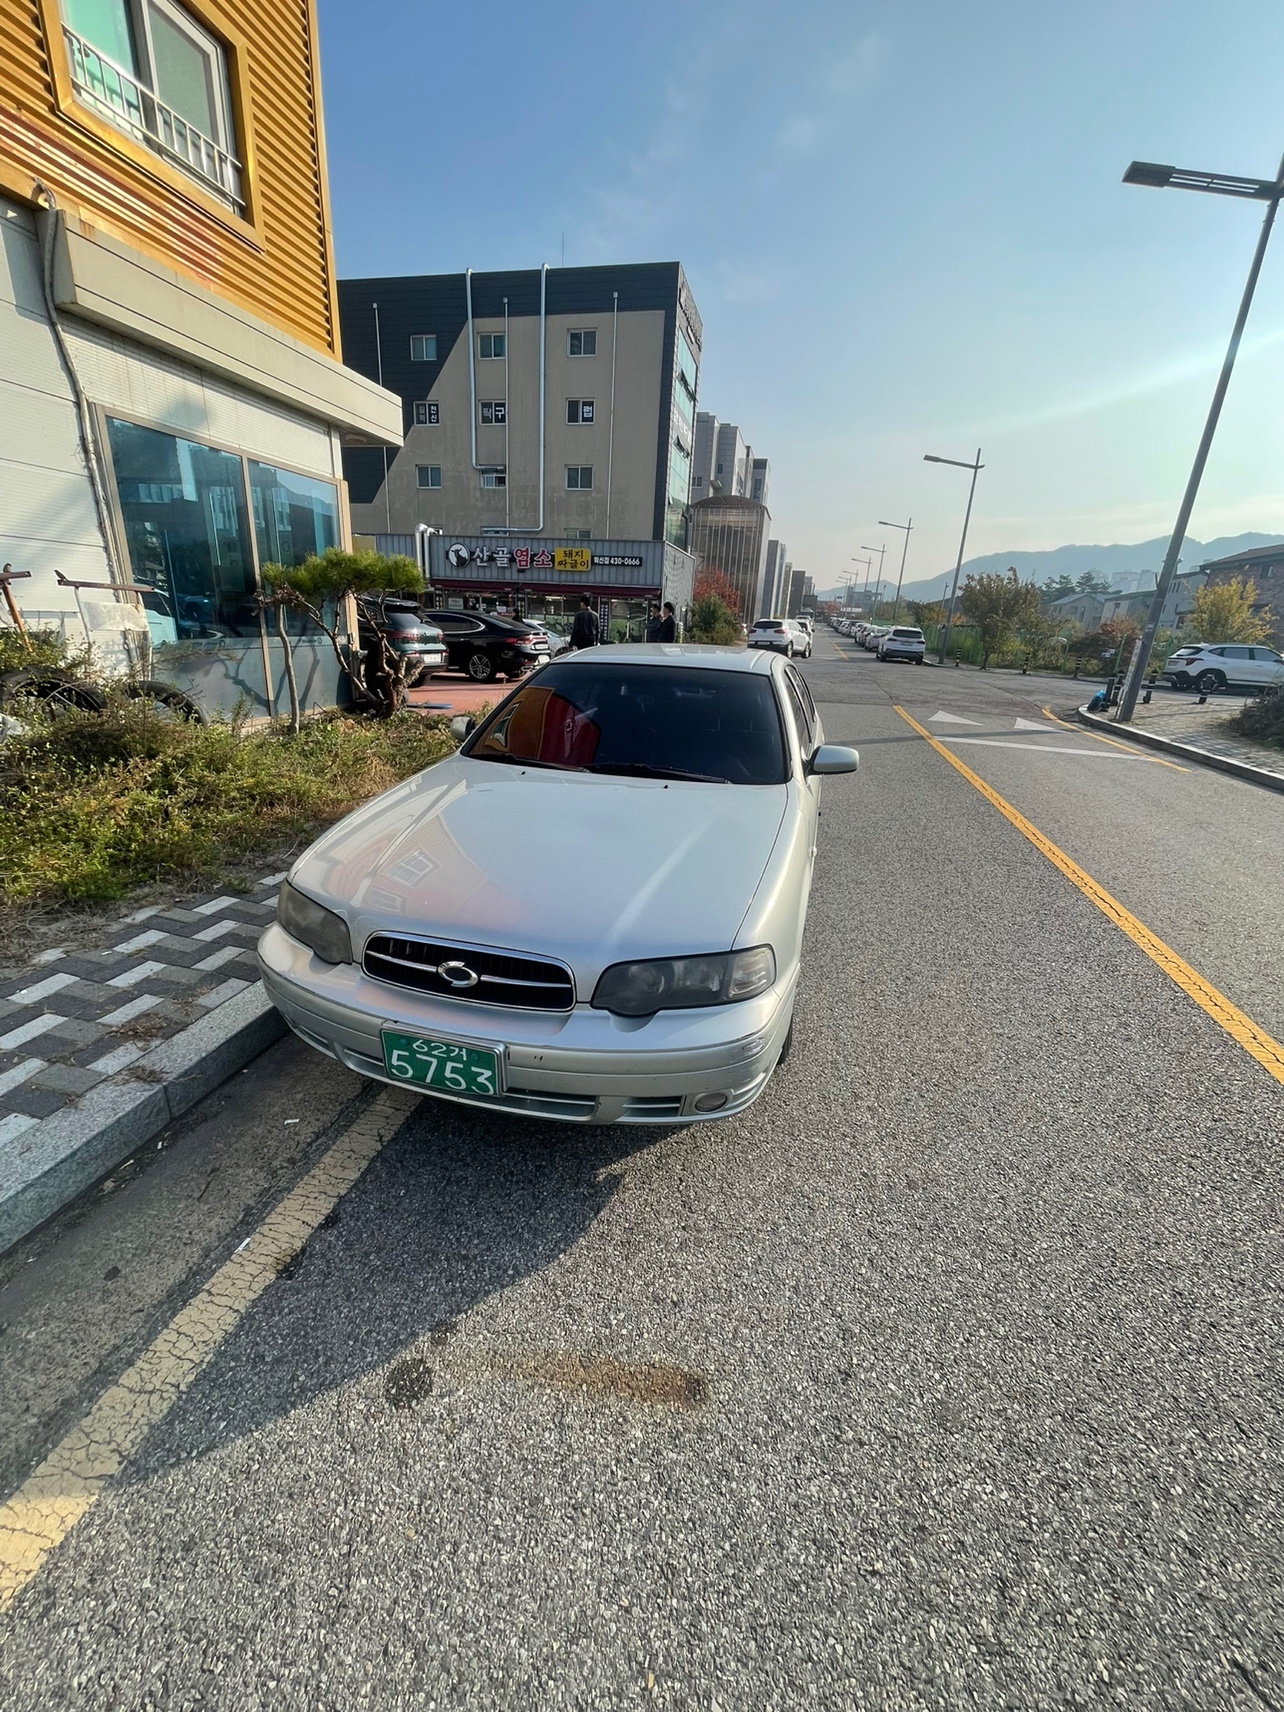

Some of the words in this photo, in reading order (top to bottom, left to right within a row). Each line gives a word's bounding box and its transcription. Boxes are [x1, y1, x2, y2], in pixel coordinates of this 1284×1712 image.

[563, 549, 584, 559] 돼지
[558, 559, 589, 569] 짜글이
[610, 557, 640, 566] 430-0666
[412, 1039, 468, 1061] 62거
[391, 1049, 495, 1096] 5753
